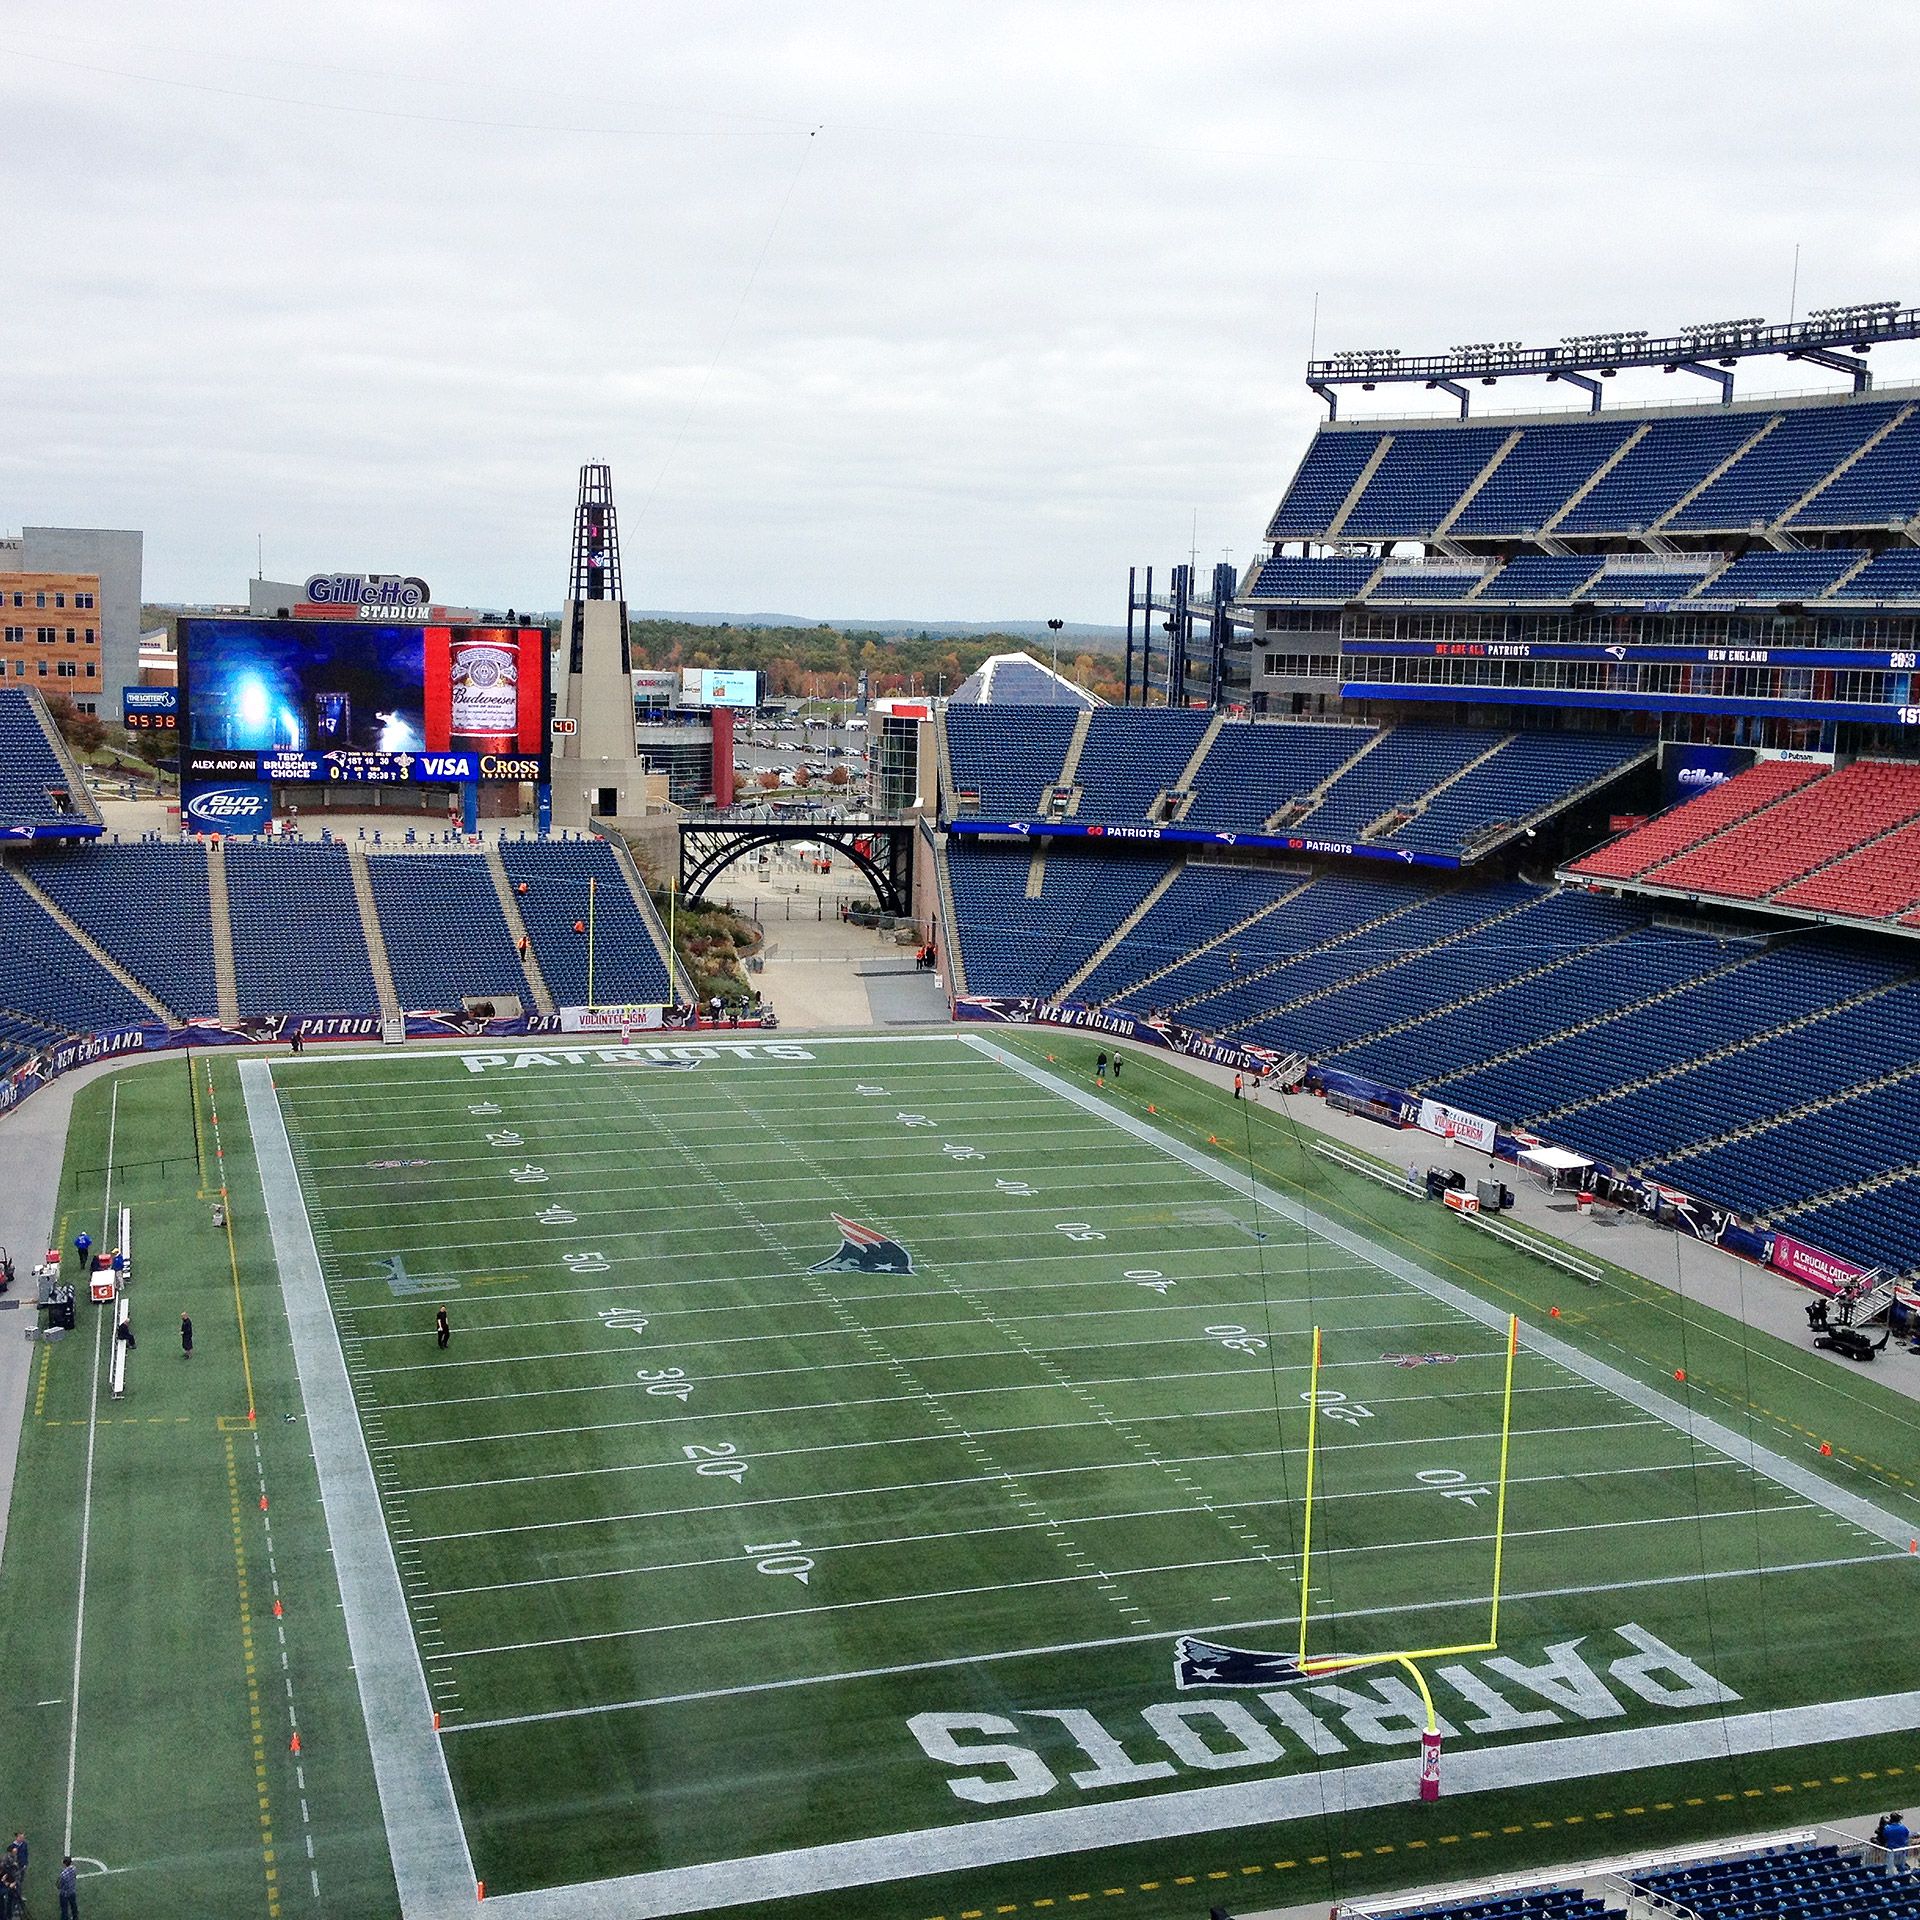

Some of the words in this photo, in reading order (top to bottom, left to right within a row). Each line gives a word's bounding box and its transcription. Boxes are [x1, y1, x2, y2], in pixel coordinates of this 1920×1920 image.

[308, 578, 419, 606] Gillette
[361, 605, 430, 619] STADIUM
[1488, 645, 1530, 656] PATRIOTS
[1708, 649, 1726, 661] NEW
[1729, 650, 1768, 662] ENGLAND
[453, 687, 516, 705] Budweiser
[554, 721, 574, 732] 40
[192, 761, 211, 769] ALEX
[212, 761, 237, 769] AND
[239, 761, 256, 769] ANI
[277, 753, 303, 761] TEDY
[348, 757, 362, 765] 1ST
[365, 757, 374, 765] 10
[380, 757, 389, 765] 30
[480, 755, 539, 773] CROSS
[1788, 752, 1814, 762] Putnam
[263, 762, 318, 770] BRUSCHI'S
[271, 770, 310, 778] CHOICE
[330, 766, 339, 779] 0
[400, 767, 409, 779] 3
[421, 758, 470, 775] VISA
[209, 795, 260, 806] BUD
[199, 806, 263, 816] LIGHT
[1087, 826, 1103, 836] GO
[1107, 827, 1161, 839] PATRIOTS
[1289, 839, 1303, 849] GO
[1306, 841, 1353, 854] PATRIOTS
[1039, 1006, 1072, 1024] NEW
[1077, 1011, 1134, 1036] ENGLAND
[57, 1046, 76, 1070] NEW
[78, 1032, 143, 1061] ENGLAND
[460, 1045, 816, 1073] PATRIOTS
[1193, 1039, 1251, 1069] PATRIOTS
[486, 1131, 525, 1147] 20
[942, 1146, 986, 1161] 30
[509, 1167, 550, 1183] 30
[1055, 1222, 1107, 1241] 50
[562, 1251, 611, 1272] 50
[1793, 1249, 1800, 1261] A
[1800, 1252, 1829, 1273] CRUCIAL
[598, 1307, 649, 1328] 40
[1204, 1325, 1268, 1352] 30
[637, 1367, 695, 1396] 30
[1300, 1390, 1375, 1421] 20
[682, 1442, 749, 1477] 20
[1415, 1469, 1492, 1498] 10
[744, 1540, 815, 1575] 10
[906, 1621, 1744, 1804] PATRIOTS
